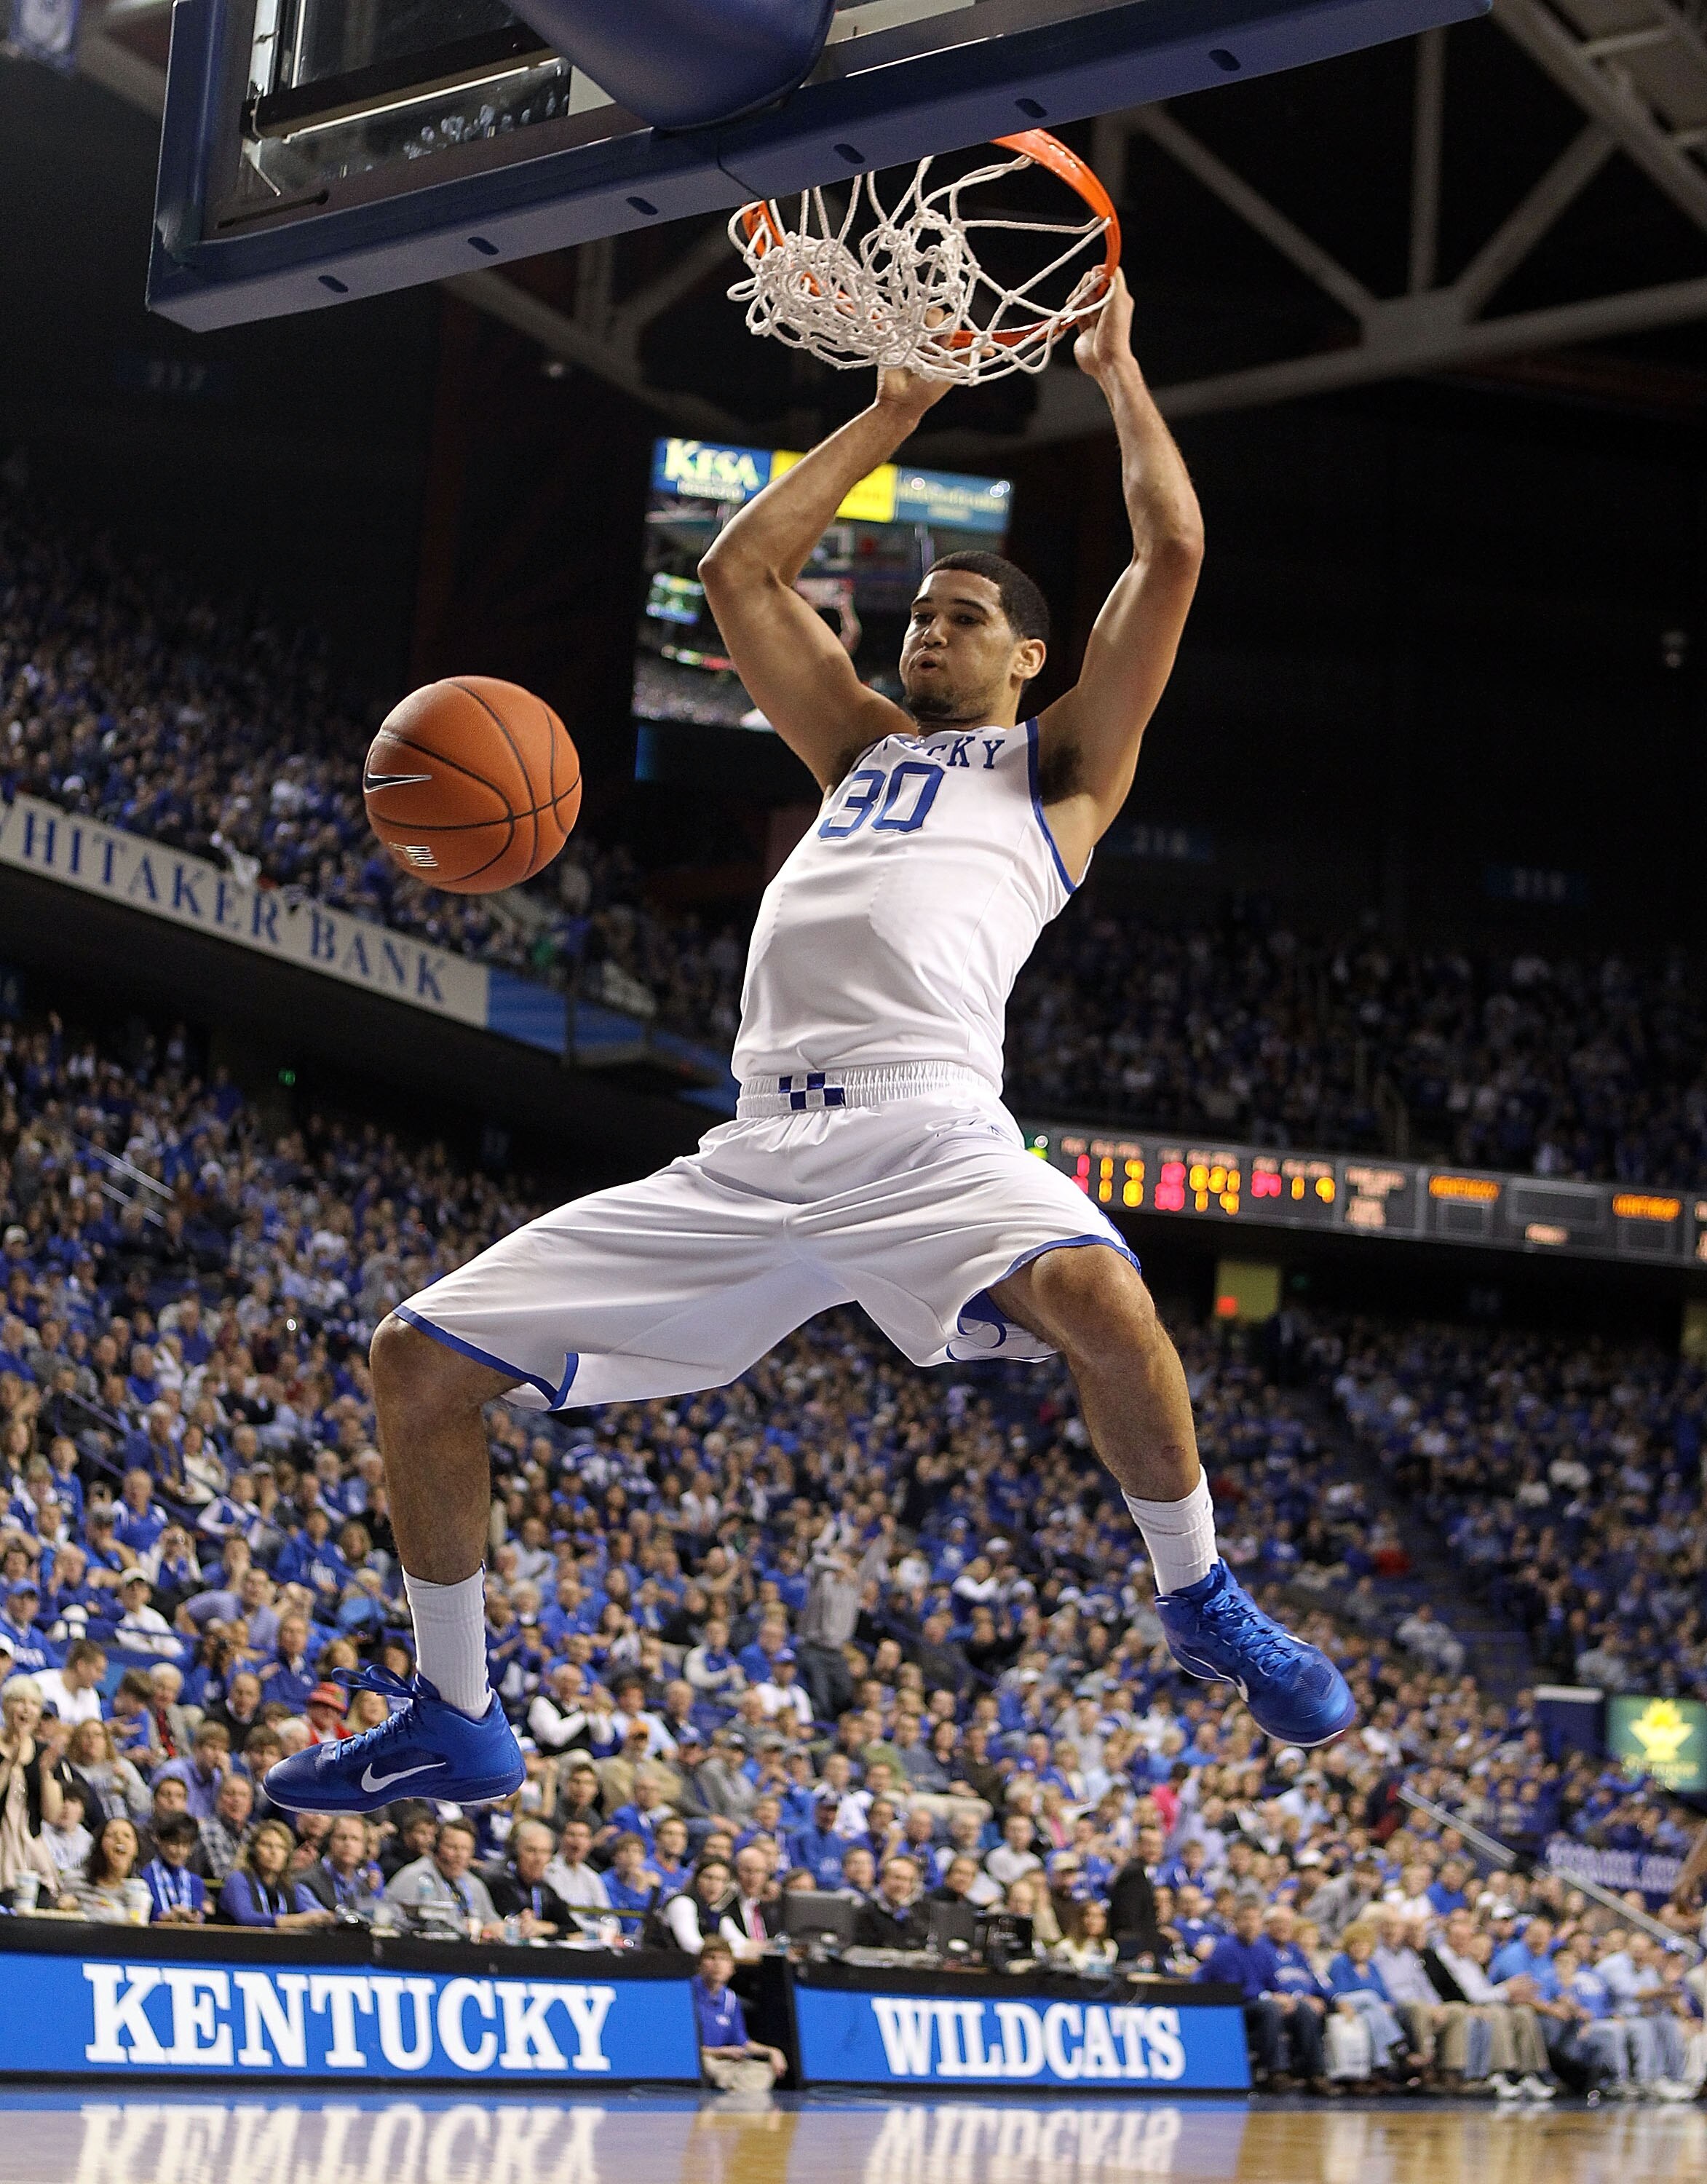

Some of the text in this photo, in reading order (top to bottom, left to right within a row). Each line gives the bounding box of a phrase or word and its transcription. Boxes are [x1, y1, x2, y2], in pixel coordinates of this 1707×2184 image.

[818, 761, 946, 842] 30
[0, 804, 445, 1003] HITAKER BANK
[82, 1963, 616, 2071] KENTUCKY
[871, 1997, 1185, 2080] WILDCATS
